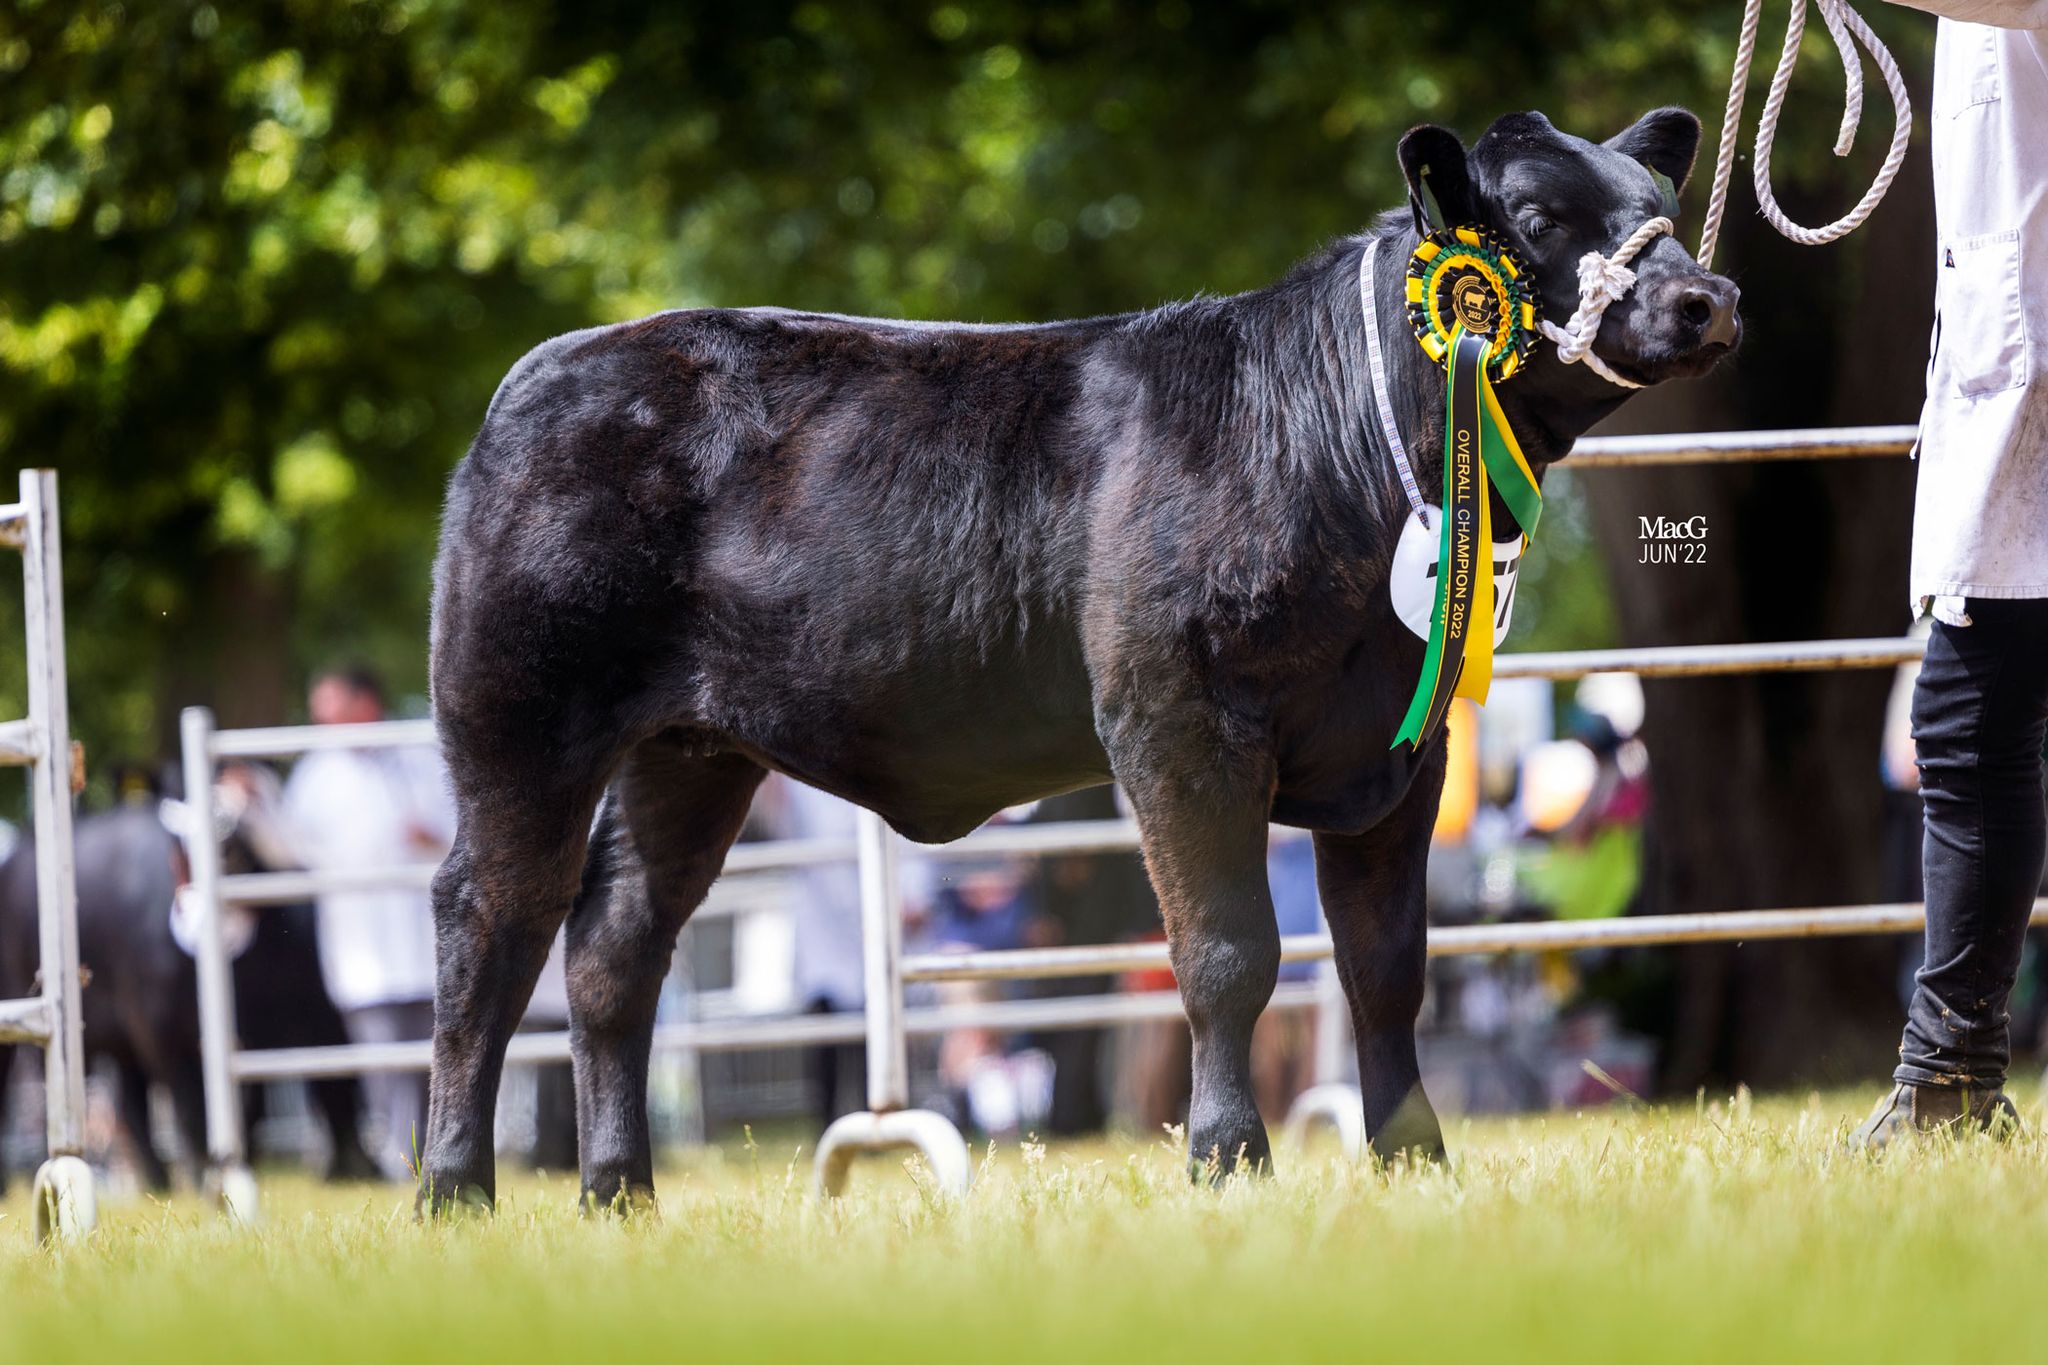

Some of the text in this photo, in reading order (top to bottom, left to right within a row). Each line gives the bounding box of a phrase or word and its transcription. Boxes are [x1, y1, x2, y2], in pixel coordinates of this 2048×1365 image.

[1450, 429, 1471, 640] OVERALL CHAMPION 2022
